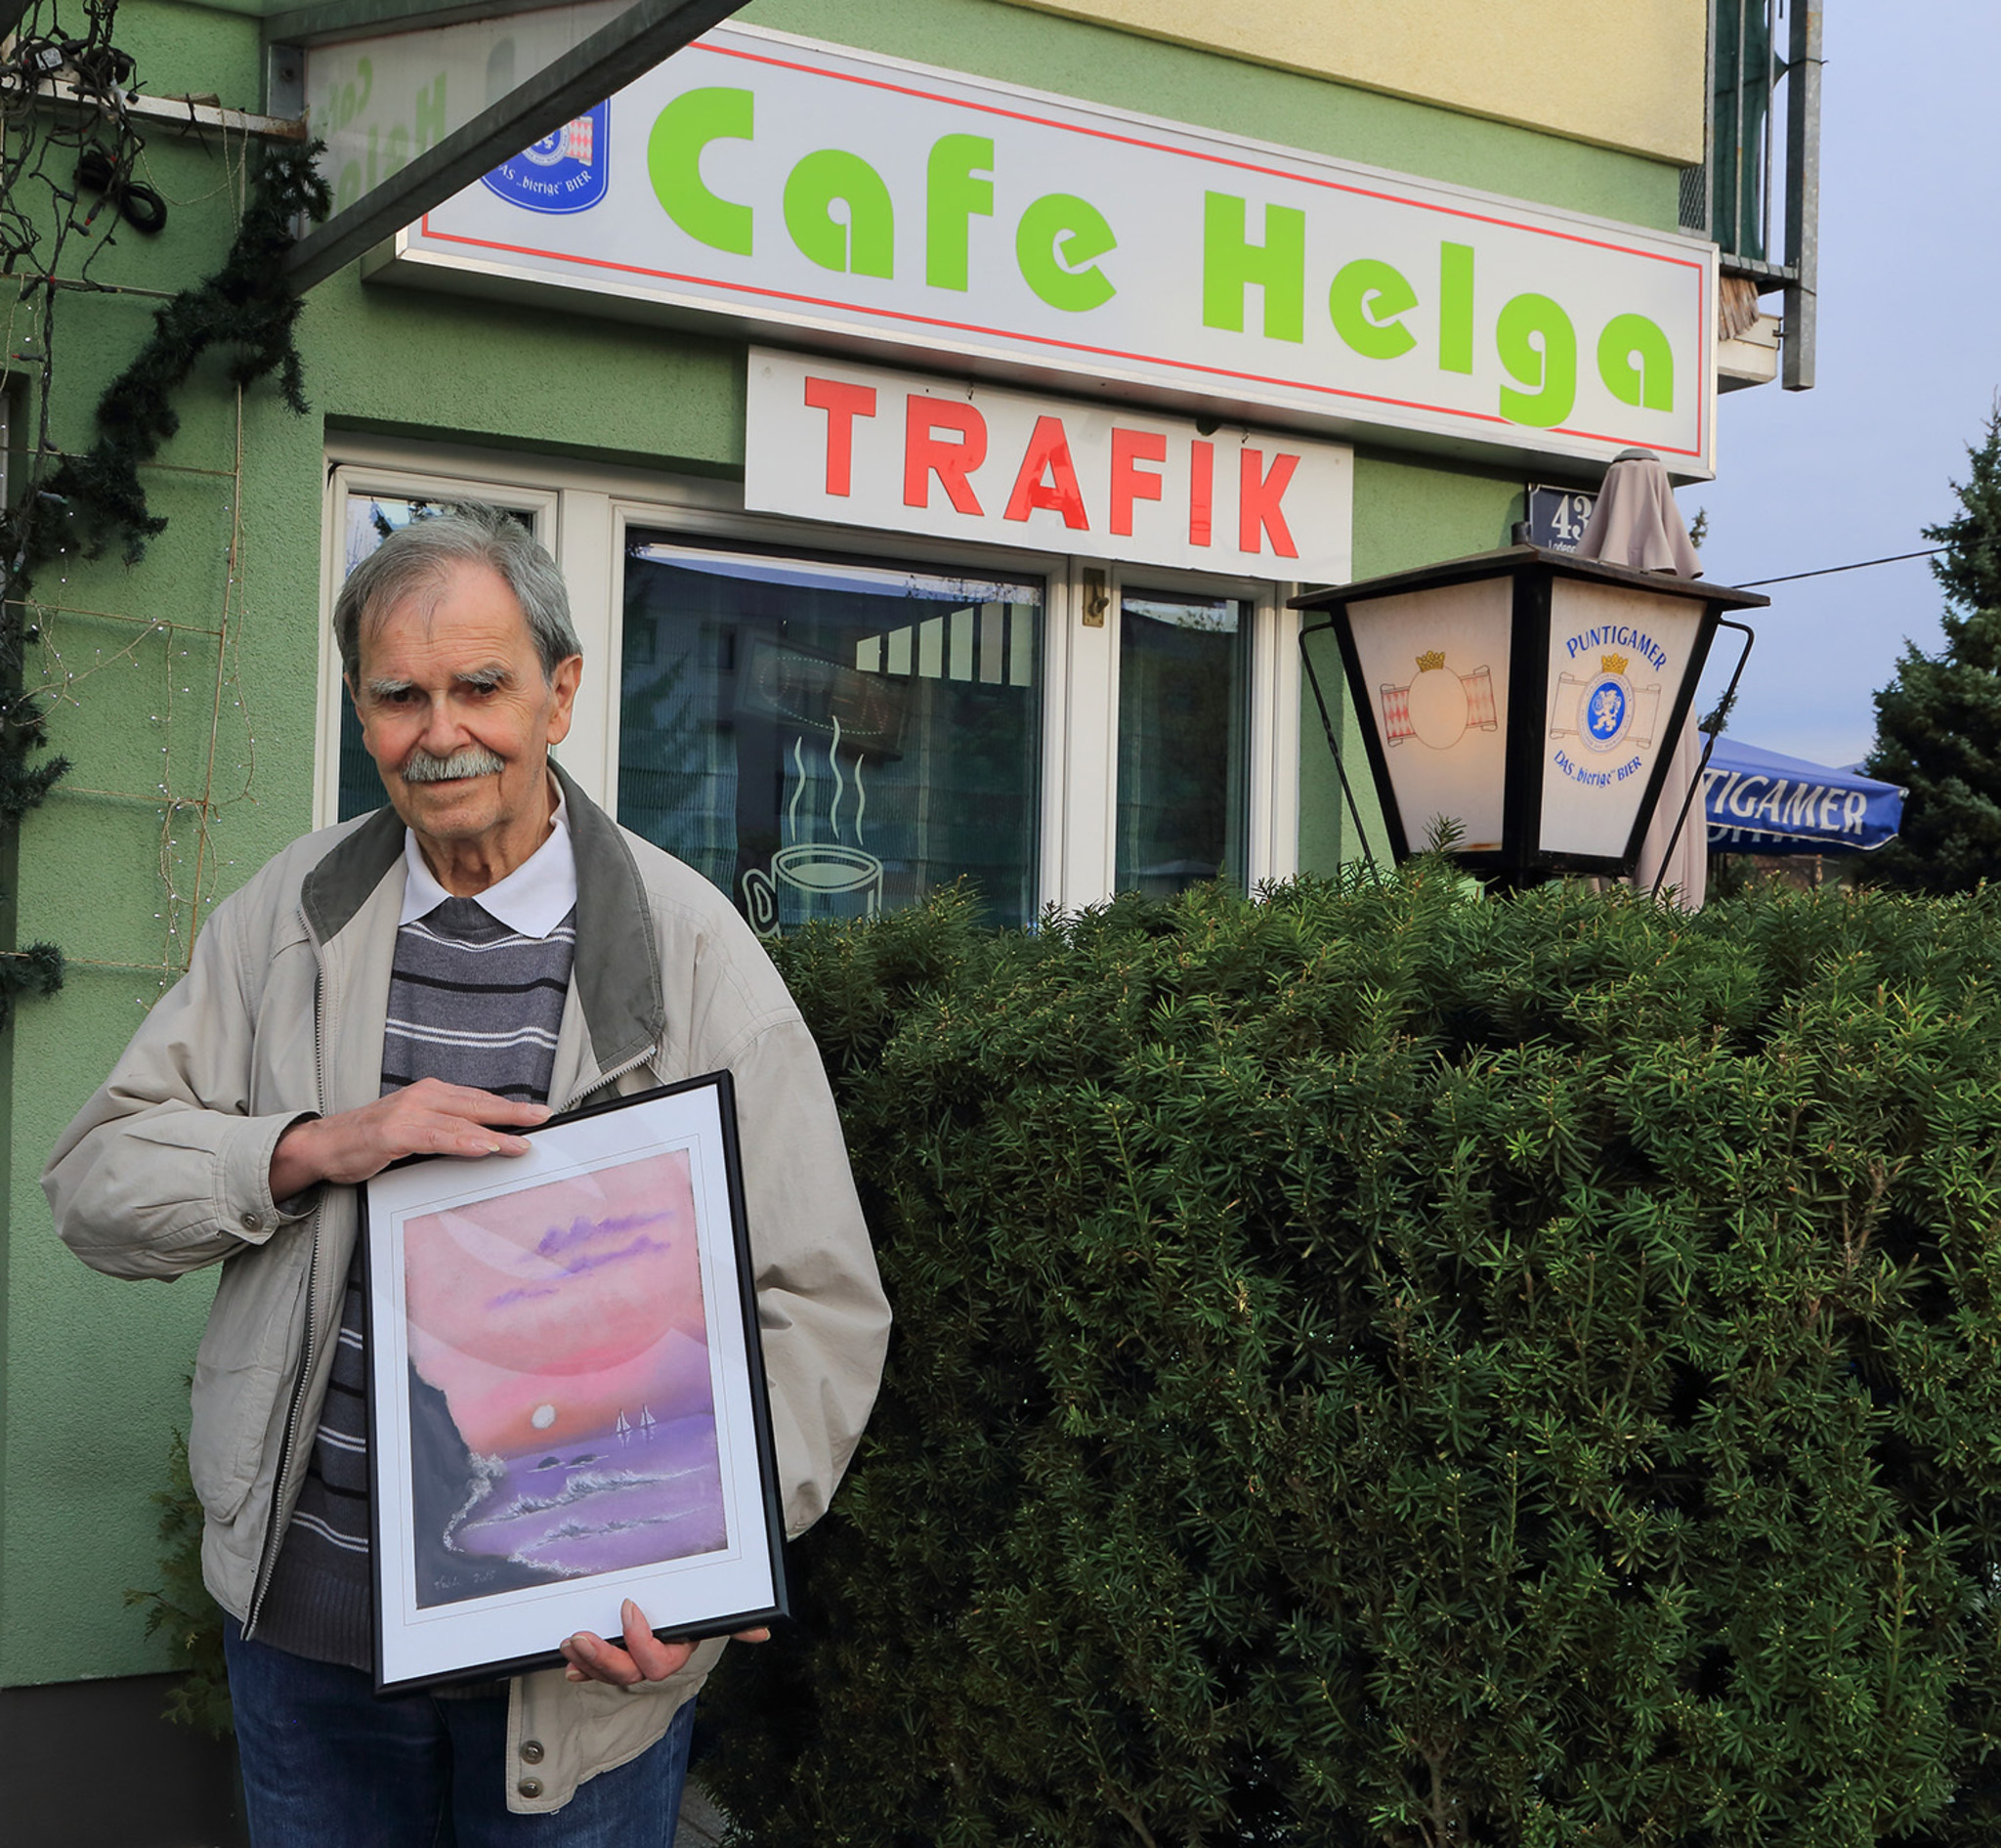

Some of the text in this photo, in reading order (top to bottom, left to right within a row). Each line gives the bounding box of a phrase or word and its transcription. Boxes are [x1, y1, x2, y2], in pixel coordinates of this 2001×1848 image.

[565, 169, 593, 193] BIER
[647, 86, 1674, 428] Cafe Helga
[804, 376, 1301, 559] TRAFIK
[1551, 494, 1593, 541] 43
[1566, 625, 1667, 671] PUNTIGAMER
[1554, 749, 1574, 777] DAS
[1617, 755, 1643, 782] BIER
